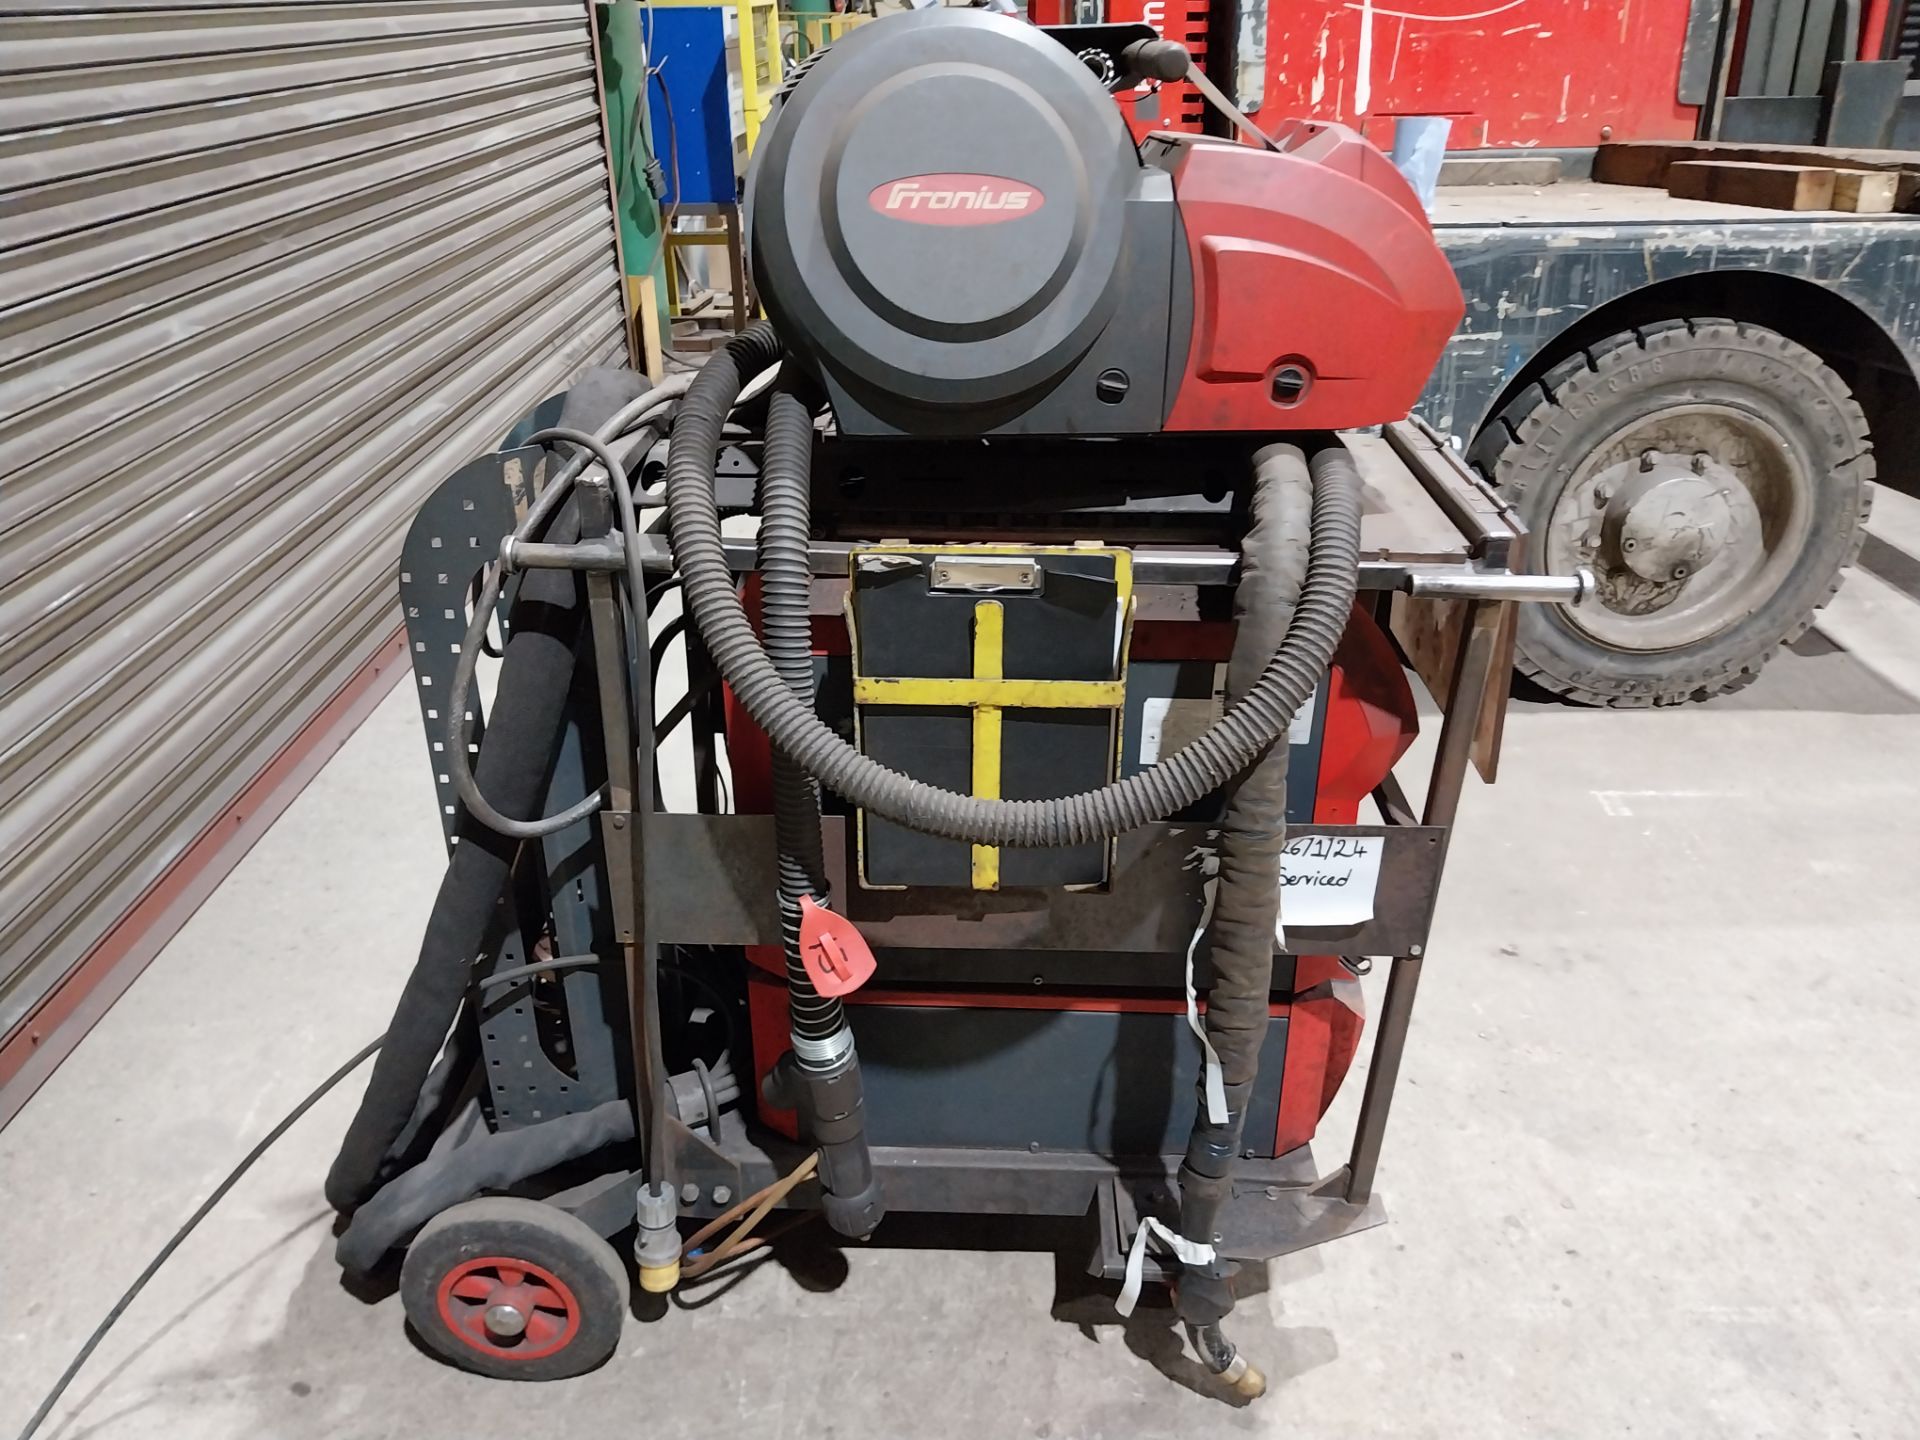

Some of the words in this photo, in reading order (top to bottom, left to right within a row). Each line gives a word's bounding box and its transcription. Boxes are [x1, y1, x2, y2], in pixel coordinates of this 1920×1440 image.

[885, 183, 1032, 210] Fronius
[1280, 837, 1368, 860] 26/1/24
[1279, 867, 1352, 887] Serviced
